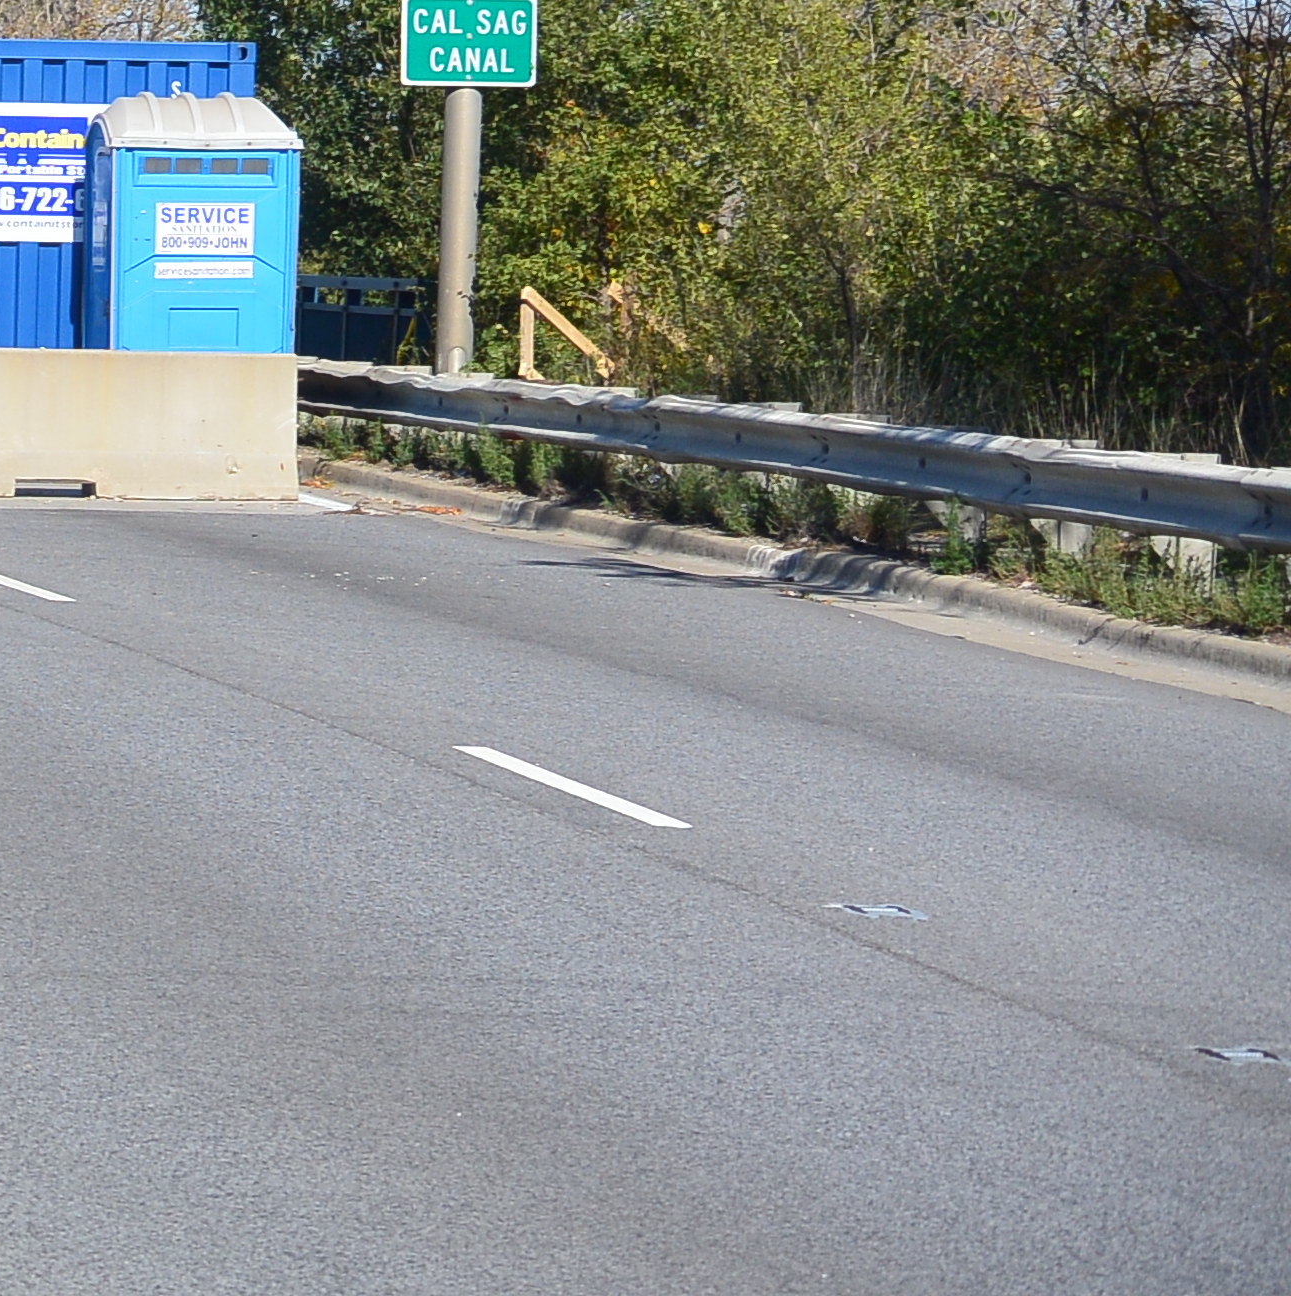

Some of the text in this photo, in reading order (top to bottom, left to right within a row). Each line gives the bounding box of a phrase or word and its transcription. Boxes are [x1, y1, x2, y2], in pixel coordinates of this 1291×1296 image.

[413, 8, 527, 35] CAL SAG
[429, 46, 515, 73] CANAL
[160, 207, 249, 224] SERVICE
